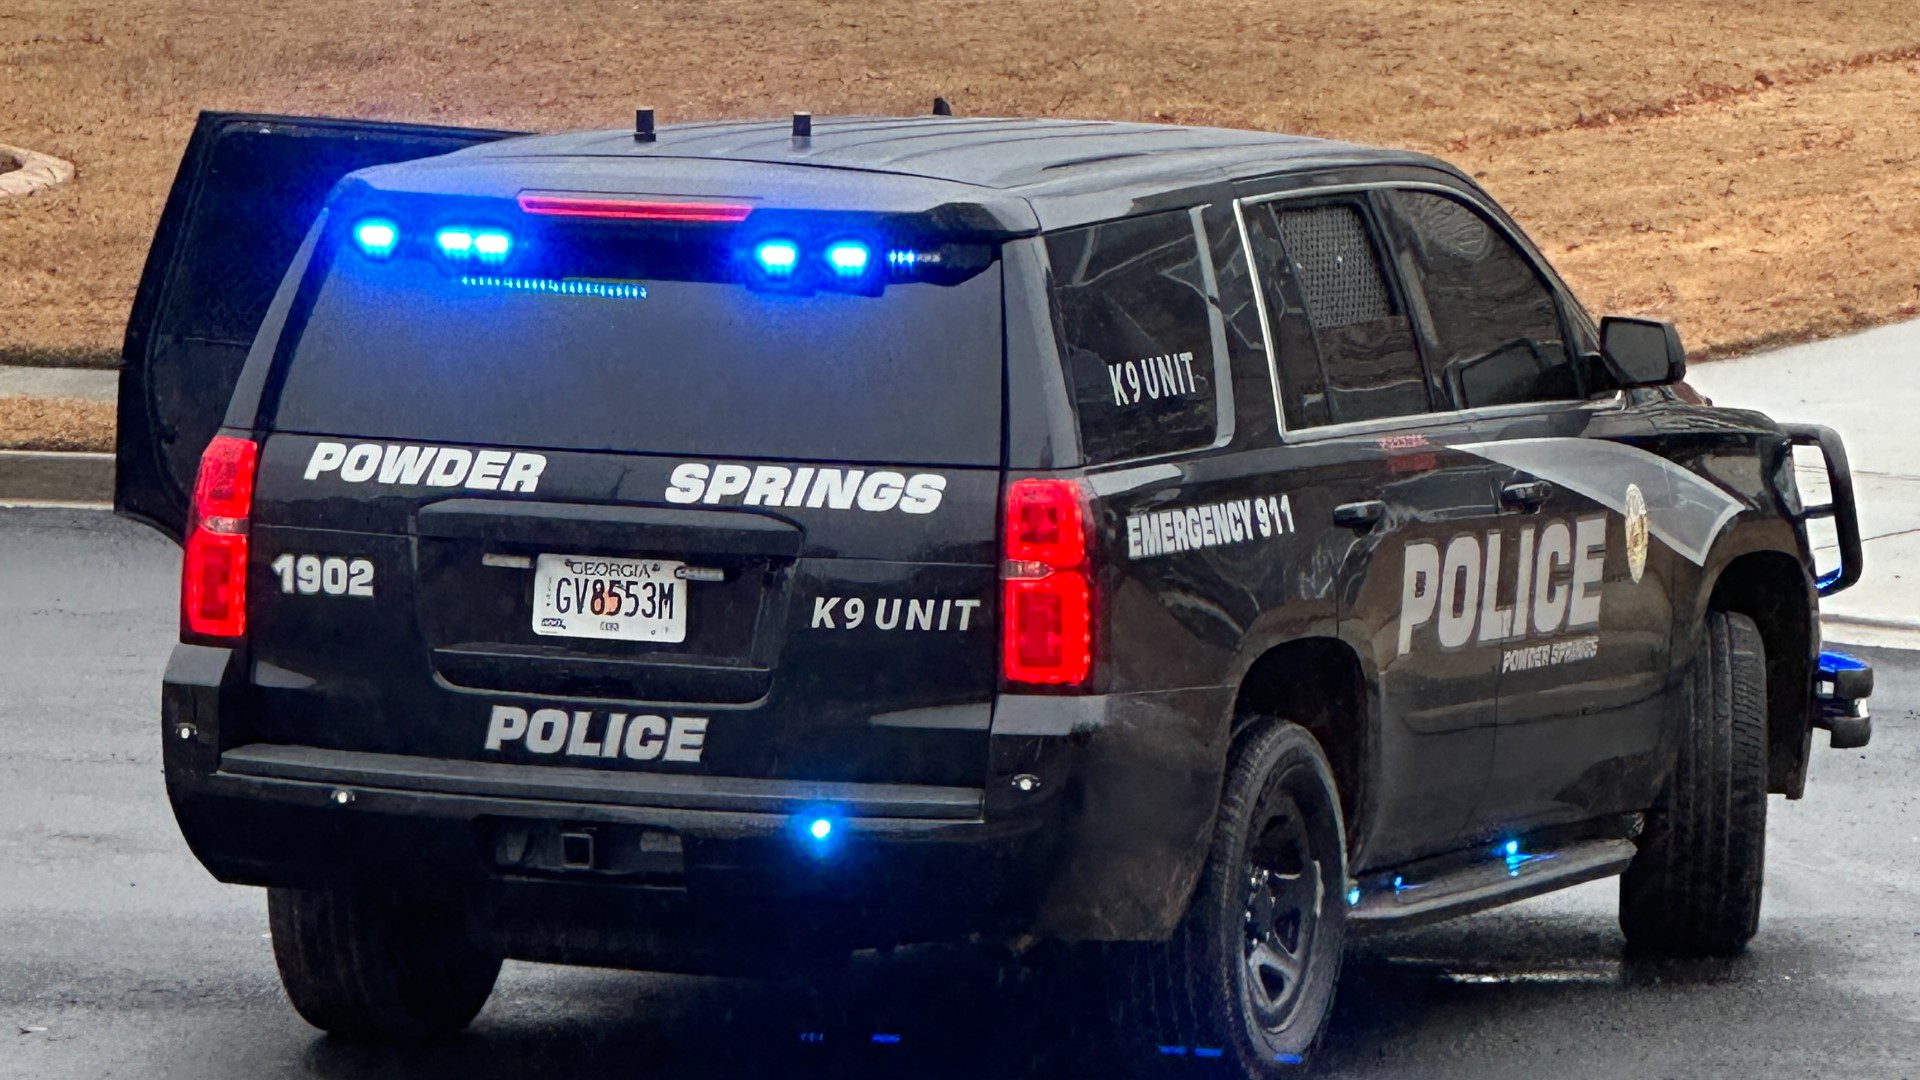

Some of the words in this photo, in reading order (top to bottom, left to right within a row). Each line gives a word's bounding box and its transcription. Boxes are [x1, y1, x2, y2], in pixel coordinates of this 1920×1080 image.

[1108, 361, 1141, 406] K9
[1141, 352, 1196, 399] UNIT
[304, 442, 547, 493] POWDER
[665, 463, 947, 514] SPRINGS
[1126, 498, 1254, 560] EMERGENCY
[1255, 493, 1295, 538] 911
[271, 553, 375, 598] 1902
[570, 560, 651, 578] GEORGIA
[1398, 516, 1607, 656] POLICE
[556, 577, 675, 620] GV8553M
[811, 597, 865, 630] K9
[875, 598, 981, 631] UNIT
[485, 705, 709, 763] POLICE
